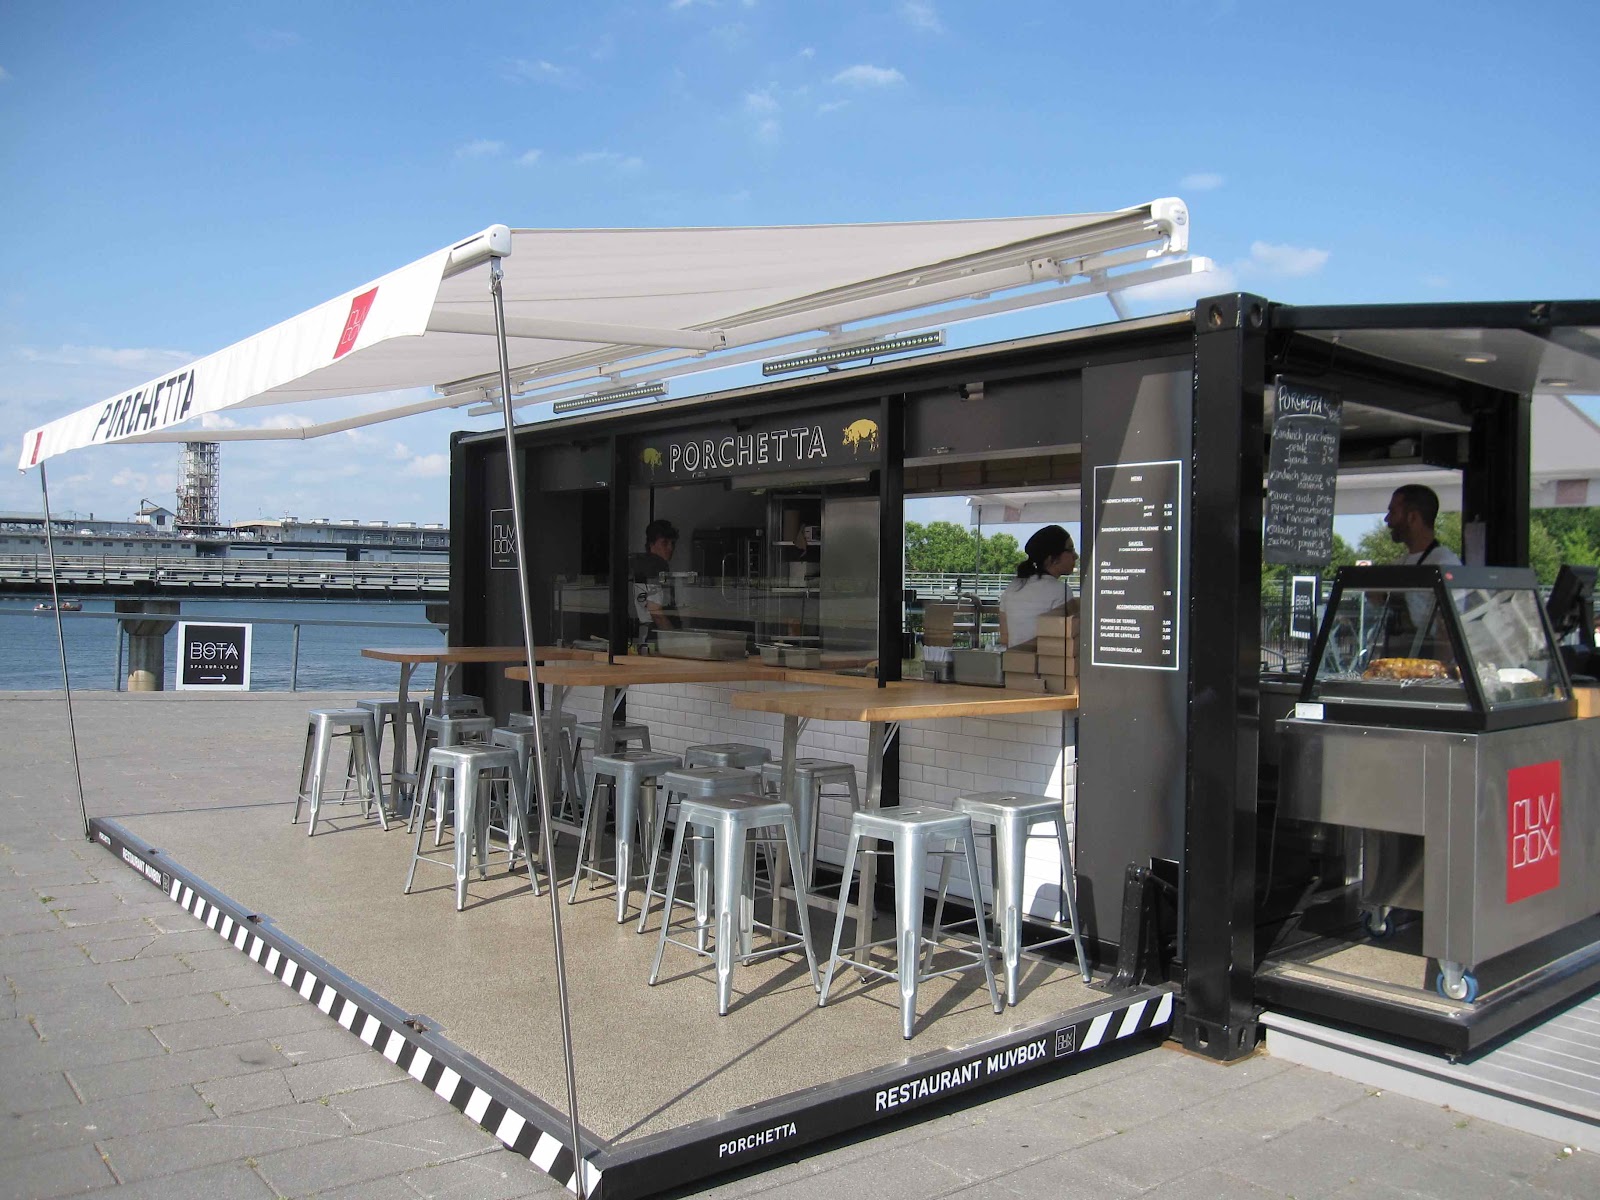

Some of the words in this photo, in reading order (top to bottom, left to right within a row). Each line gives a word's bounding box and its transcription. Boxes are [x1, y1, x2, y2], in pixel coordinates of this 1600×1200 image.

[91, 369, 195, 441] PORCHETTA
[1278, 385, 1322, 414] PORCHETTA
[669, 426, 828, 473] PORCHETTA
[190, 642, 239, 660] BOTA
[1513, 792, 1555, 834] MUV
[1513, 825, 1555, 868] BOX
[875, 1060, 982, 1111] RESTAURANT
[987, 1039, 1047, 1075] MUVBOX
[719, 1122, 797, 1158] PORCHETTA
